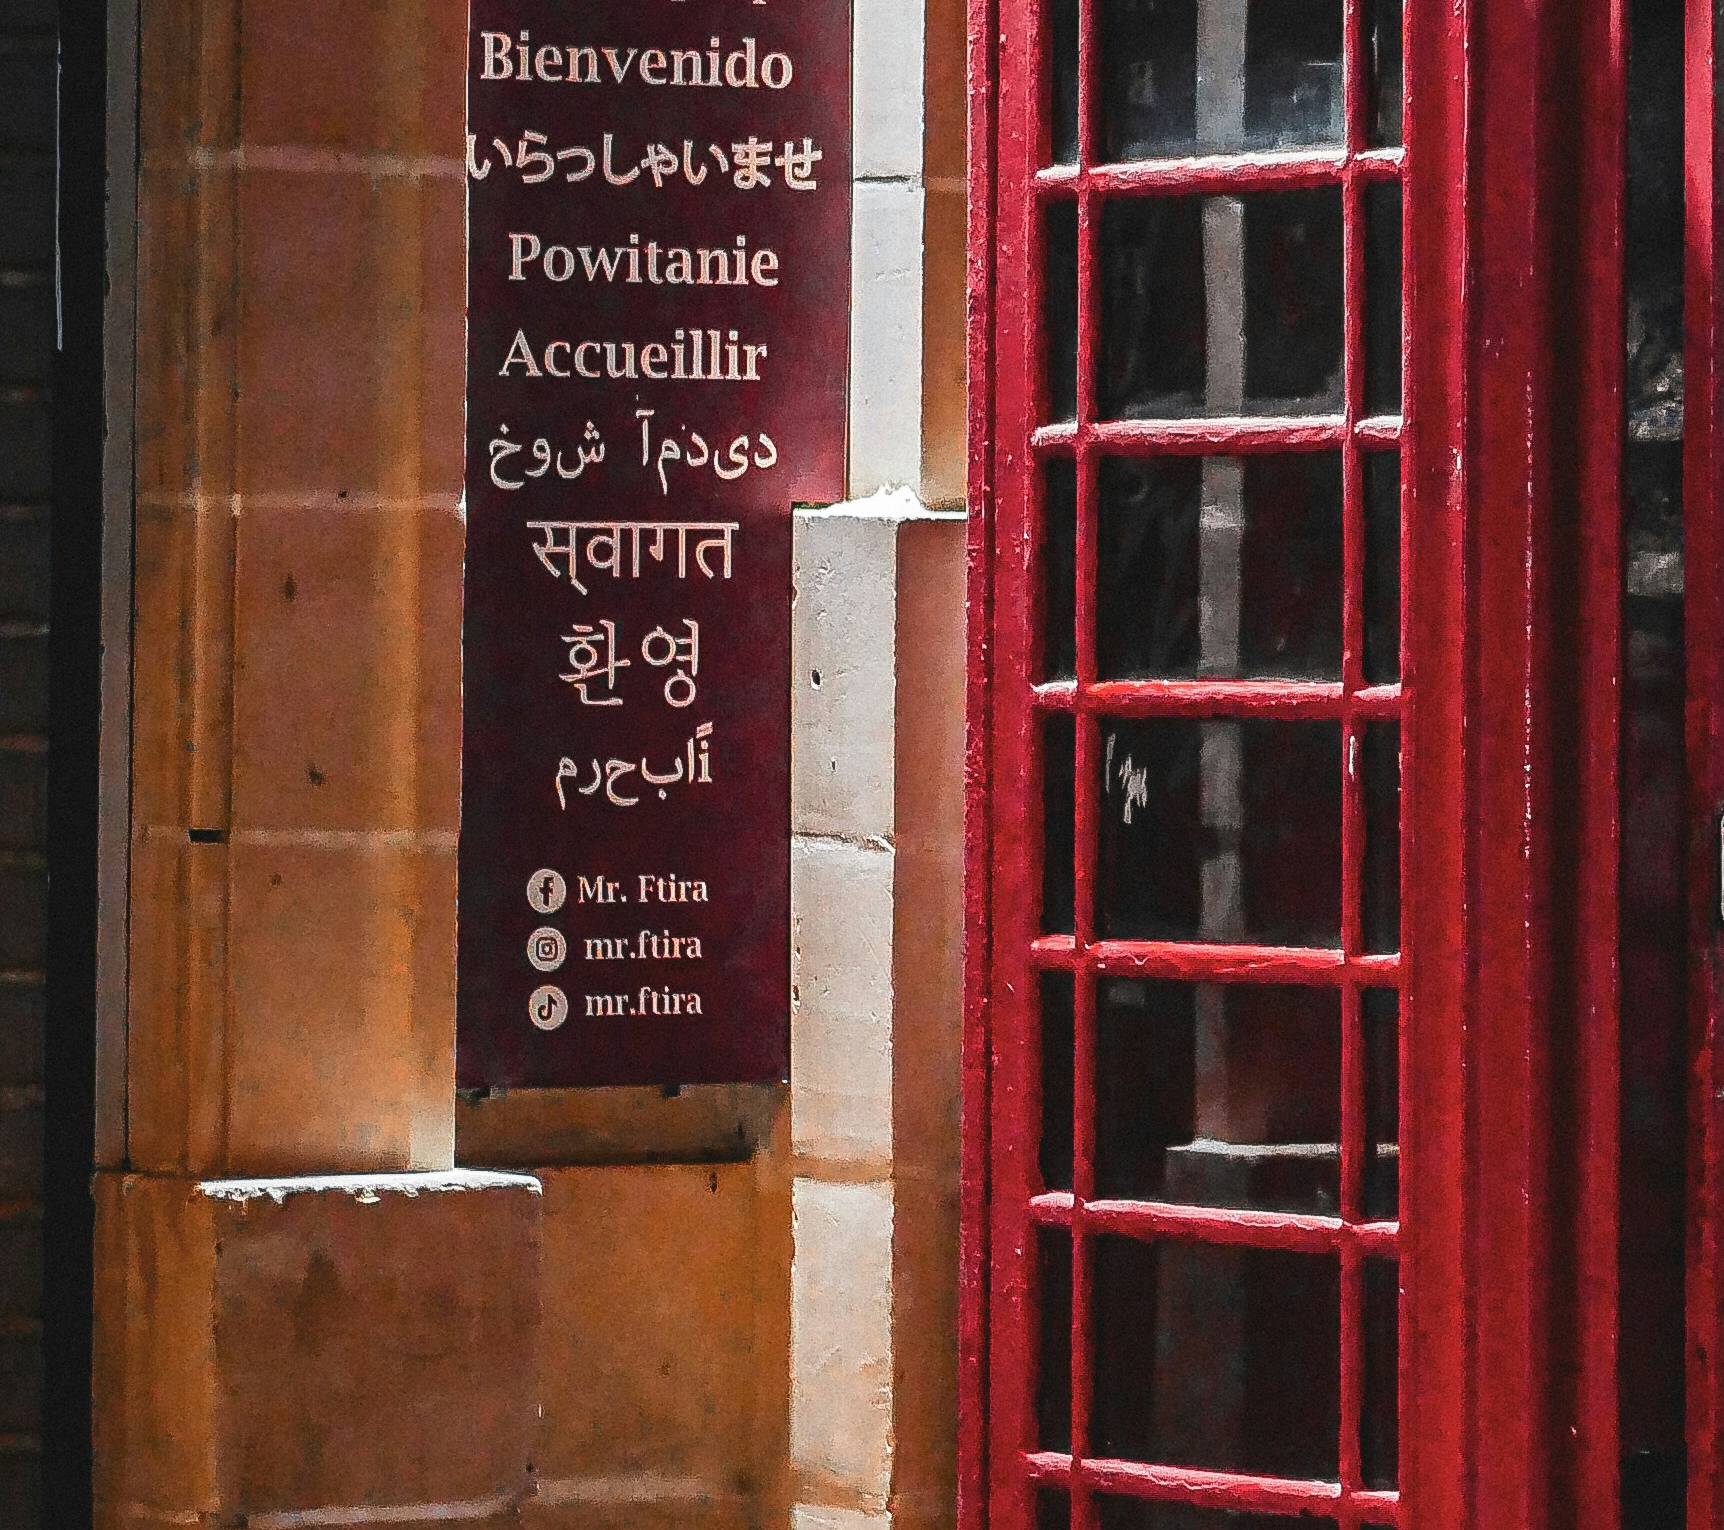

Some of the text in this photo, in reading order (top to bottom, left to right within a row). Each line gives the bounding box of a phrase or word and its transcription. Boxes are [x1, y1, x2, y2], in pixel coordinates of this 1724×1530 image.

[480, 29, 794, 90] Bienvenido
[468, 129, 823, 191] いらっしゃいませ
[508, 232, 779, 287] Powitanie
[498, 328, 768, 382] Accueillir
[576, 874, 709, 904] Mr. Ftira
[584, 929, 703, 960] mr.ftira
[585, 986, 704, 1017] mr.ftira
